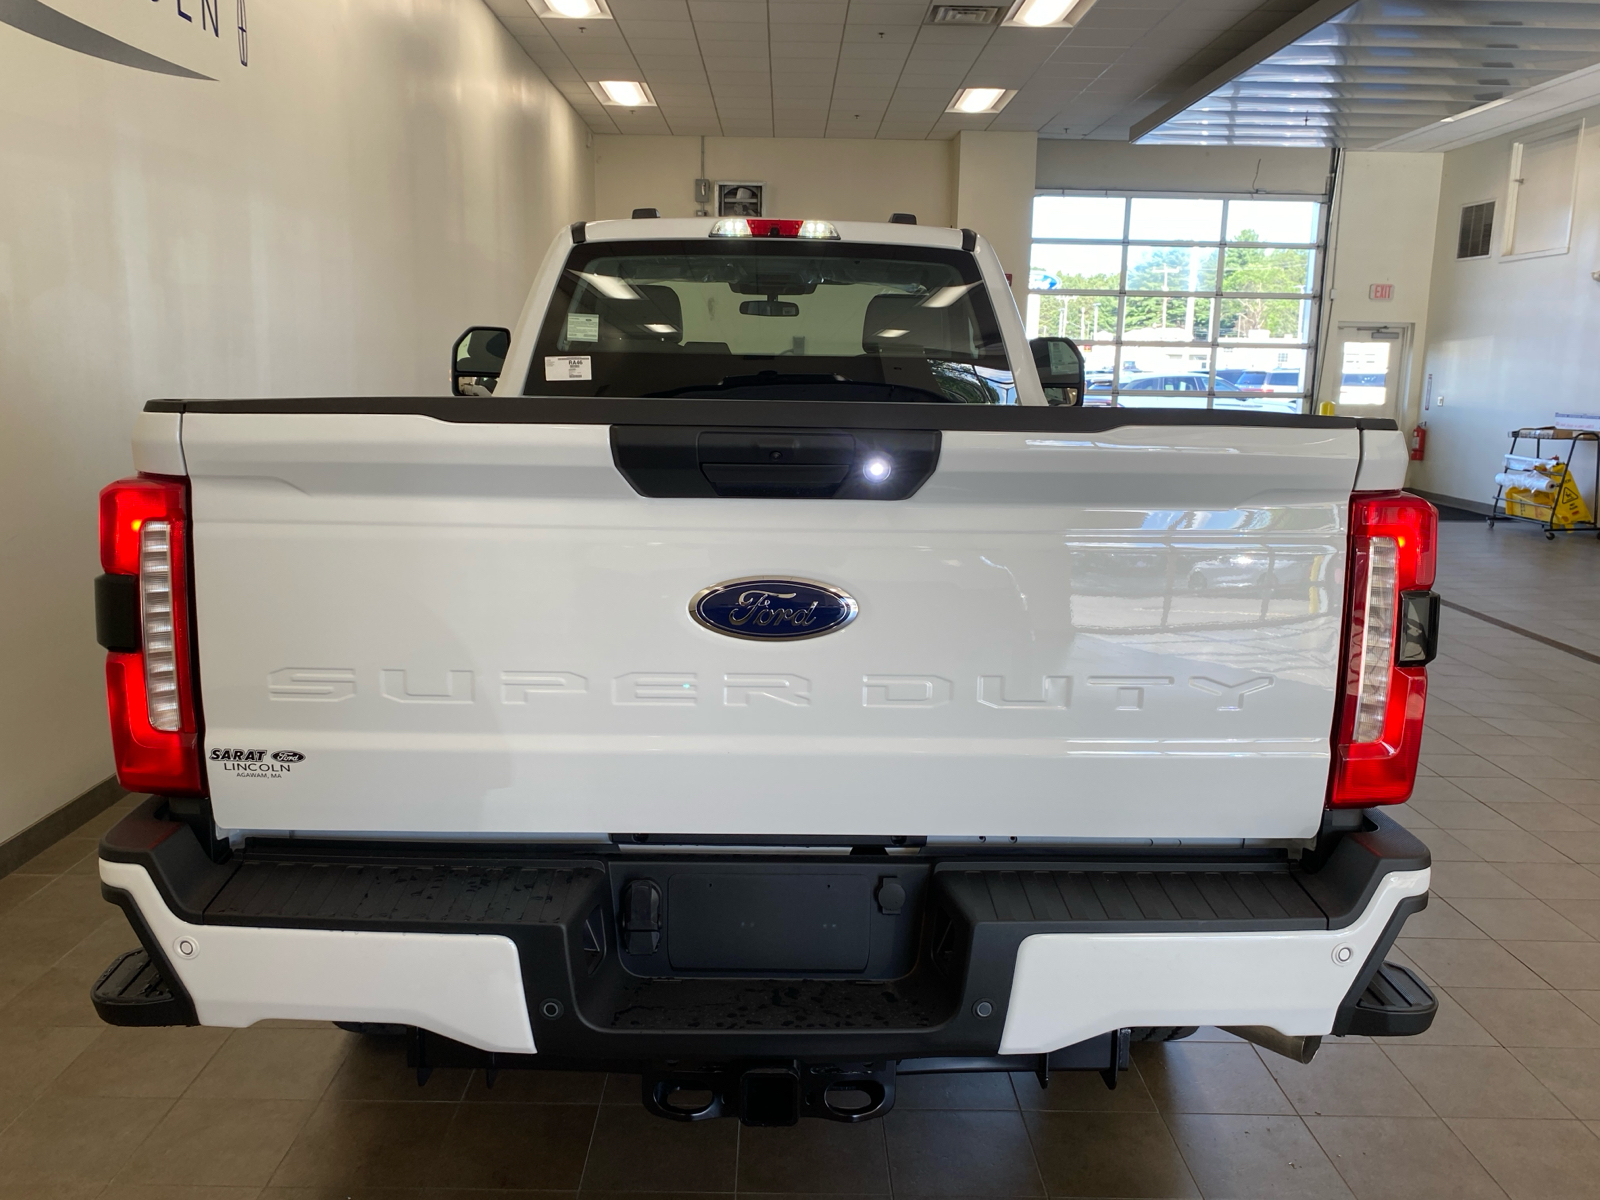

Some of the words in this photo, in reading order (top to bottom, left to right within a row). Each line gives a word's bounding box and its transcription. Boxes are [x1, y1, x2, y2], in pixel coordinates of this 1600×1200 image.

[1374, 284, 1392, 298] EXIT
[728, 589, 819, 627] Ford
[267, 666, 812, 708] SUPER
[862, 674, 1276, 712] DUTY
[209, 748, 267, 762] SARAT
[223, 762, 291, 772] LINCOLN
